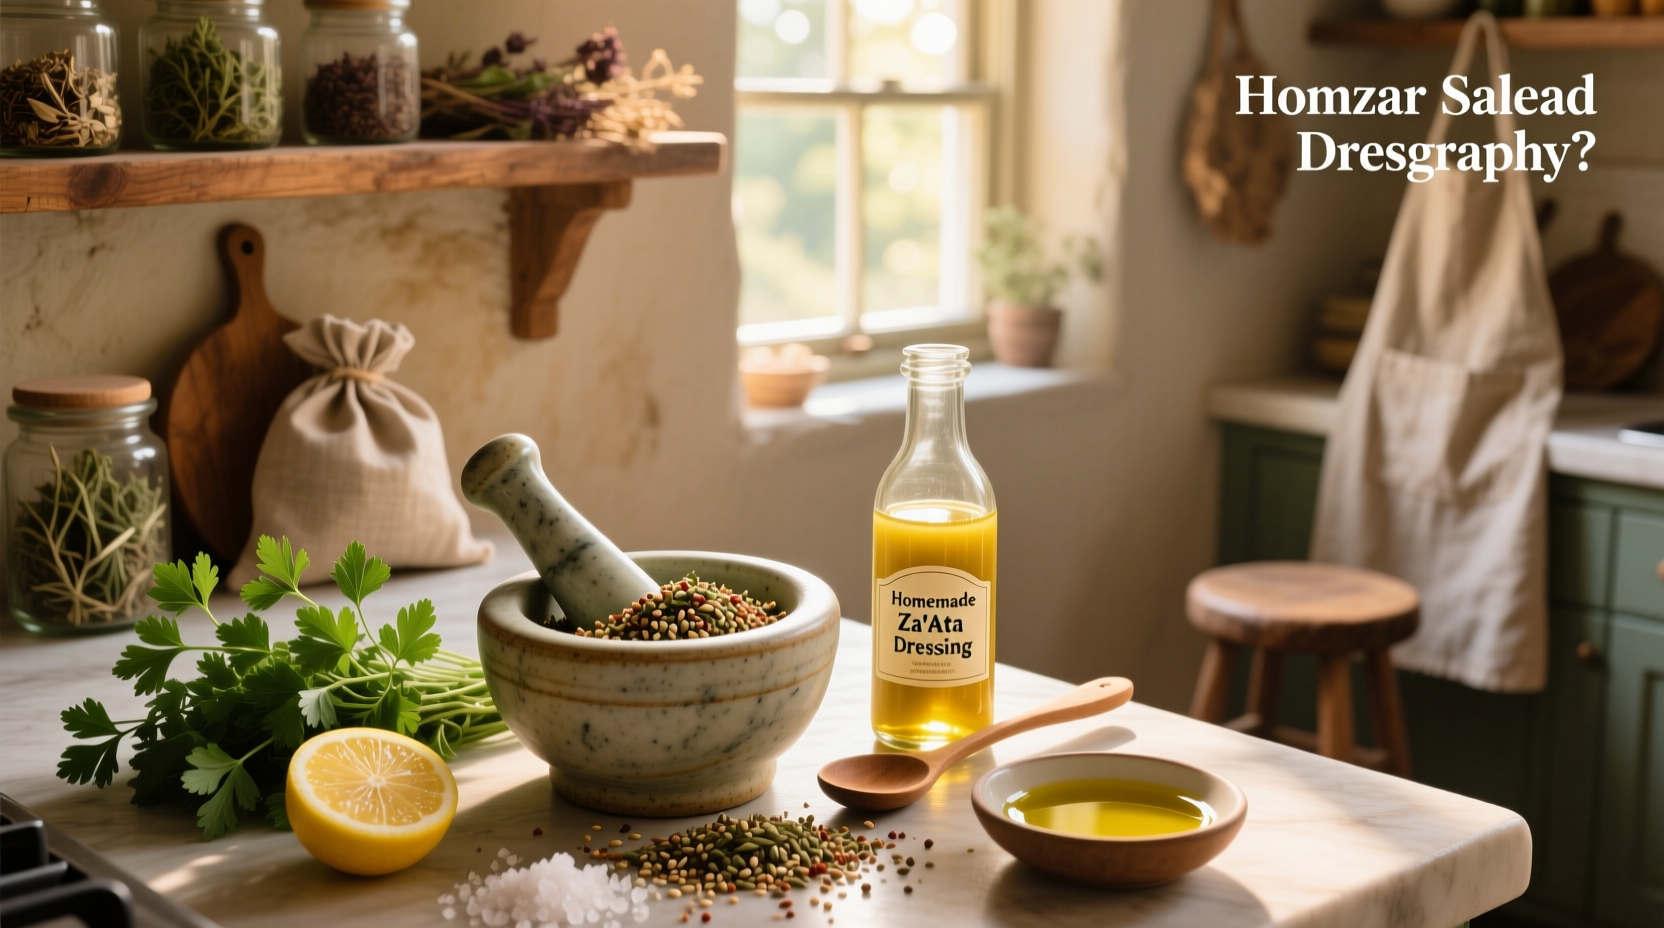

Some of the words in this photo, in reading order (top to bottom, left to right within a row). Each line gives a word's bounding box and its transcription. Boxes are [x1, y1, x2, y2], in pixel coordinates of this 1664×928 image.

[891, 590, 977, 609] Homemade
[897, 612, 964, 634] Za'Ata
[894, 635, 973, 659] Dressing
